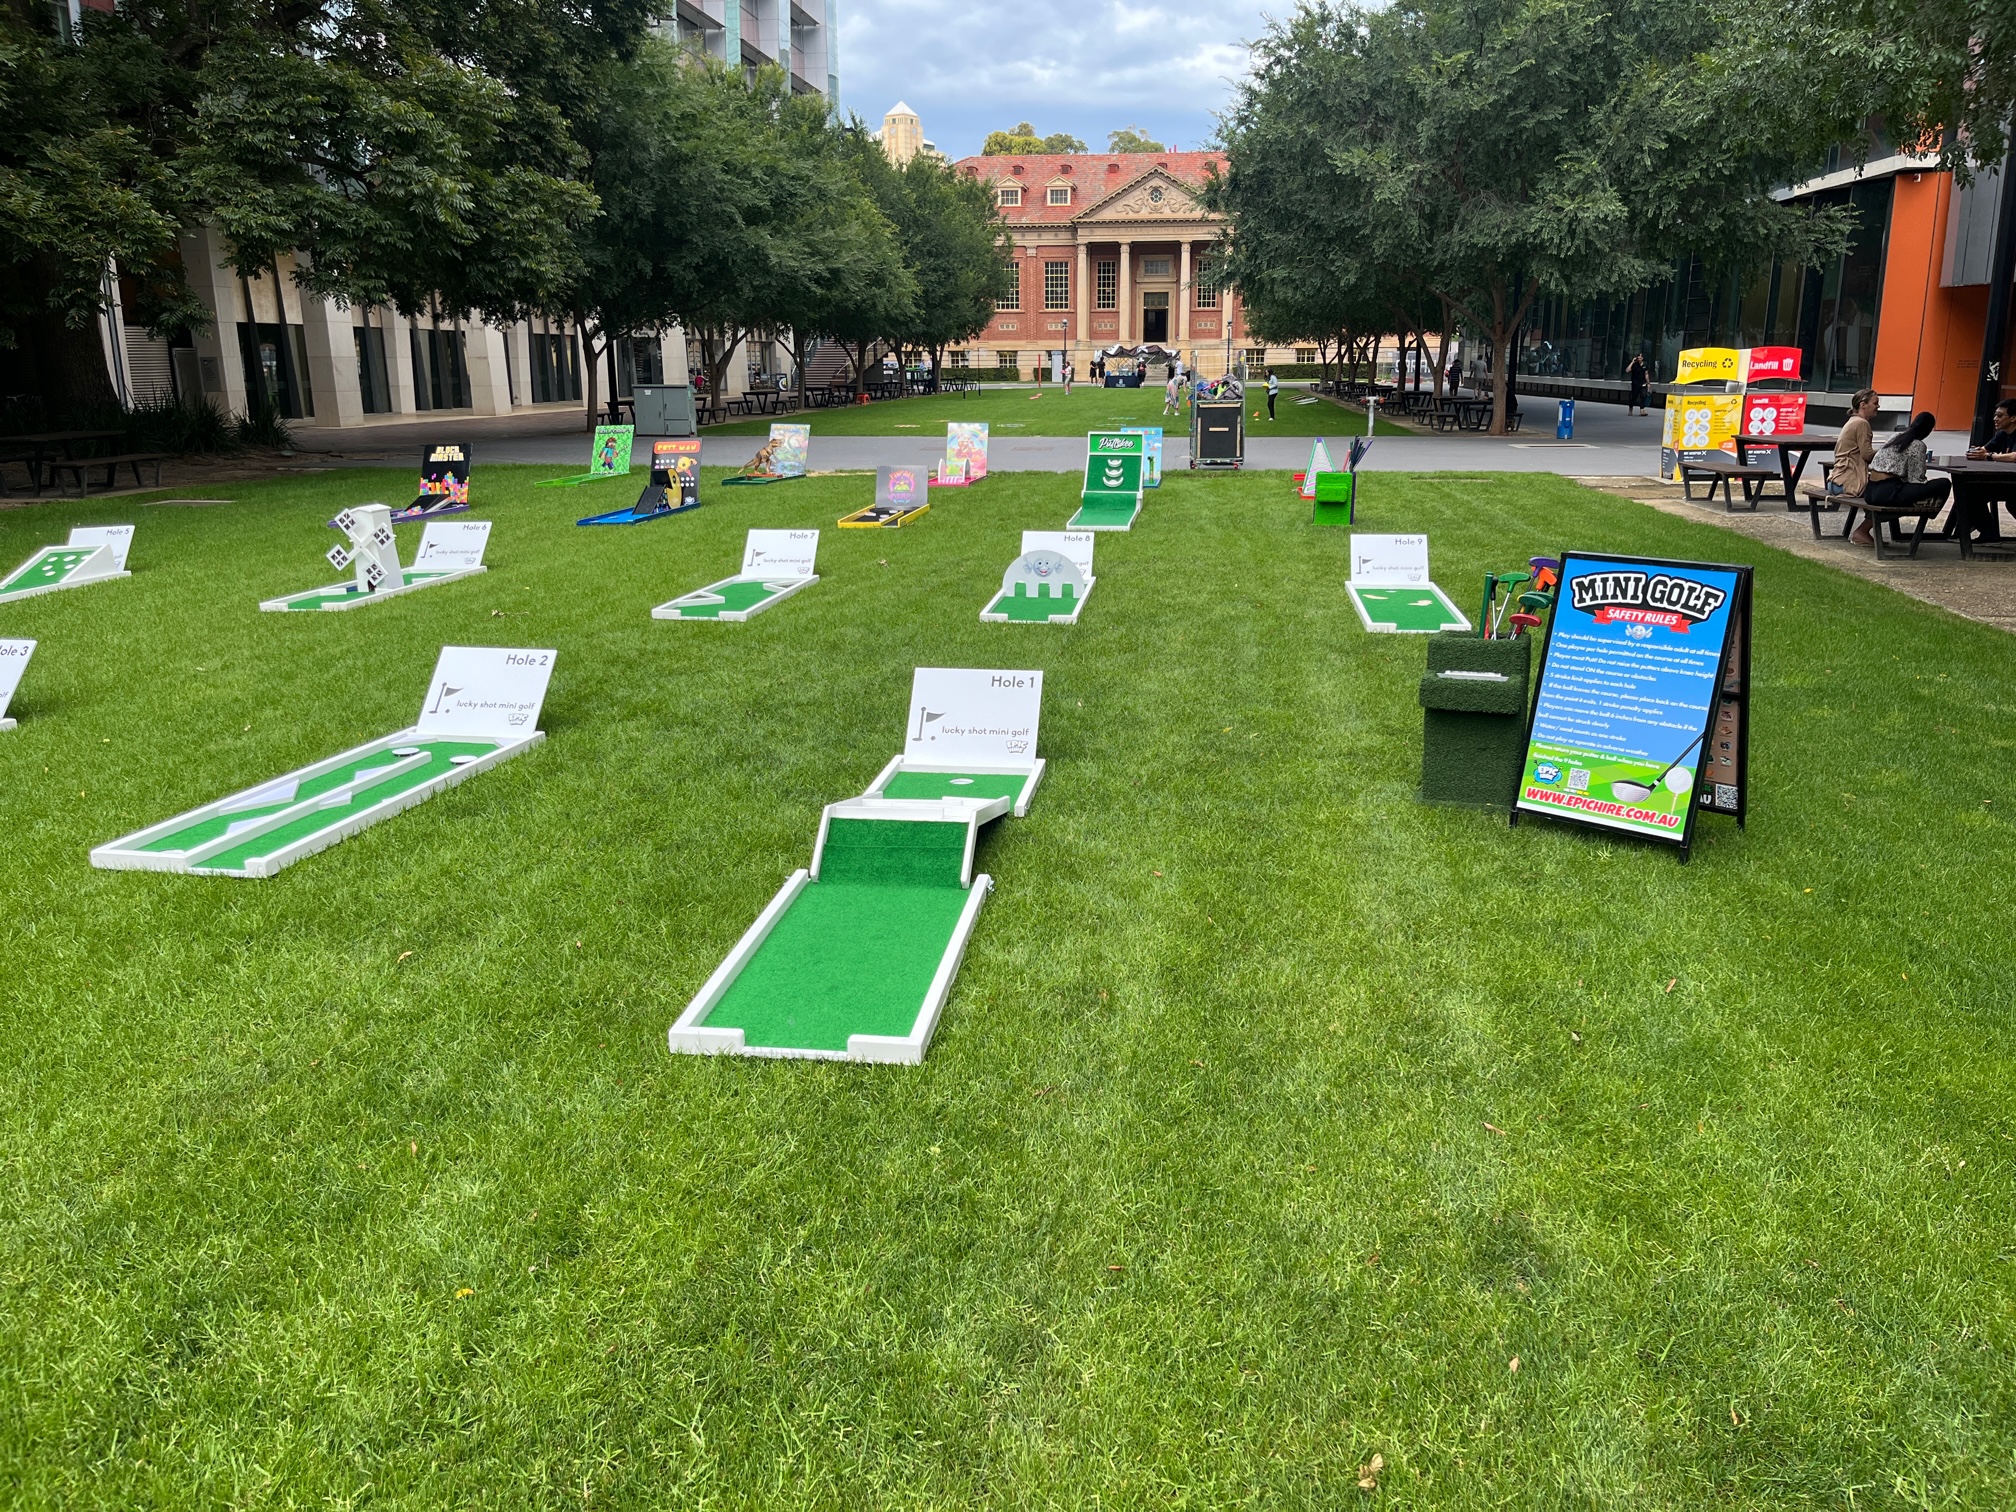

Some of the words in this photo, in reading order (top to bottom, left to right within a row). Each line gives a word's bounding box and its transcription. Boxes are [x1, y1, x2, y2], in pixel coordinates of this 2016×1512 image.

[1682, 360, 1717, 369] Recycling
[1750, 361, 1779, 370] Landfill
[430, 453, 464, 462] MASTER
[1574, 575, 1645, 606] MINI
[1649, 576, 1723, 617] GOLF
[1607, 609, 1644, 621] SAFETY
[1645, 613, 1678, 625] RULES
[20, 646, 29, 656] 3
[505, 654, 536, 665] Hole
[539, 655, 549, 666] 2
[991, 676, 1025, 688] Hole
[1029, 677, 1035, 688] 1
[457, 700, 478, 709] lucky
[518, 702, 535, 711] golf
[942, 726, 966, 736] lucky
[968, 727, 987, 735] shot
[1011, 728, 1030, 737] golf
[1006, 740, 1028, 748] EPIC
[1537, 766, 1559, 776] EPIC
[1526, 787, 1680, 828] WWW.EPICHIRE.COM.AU
